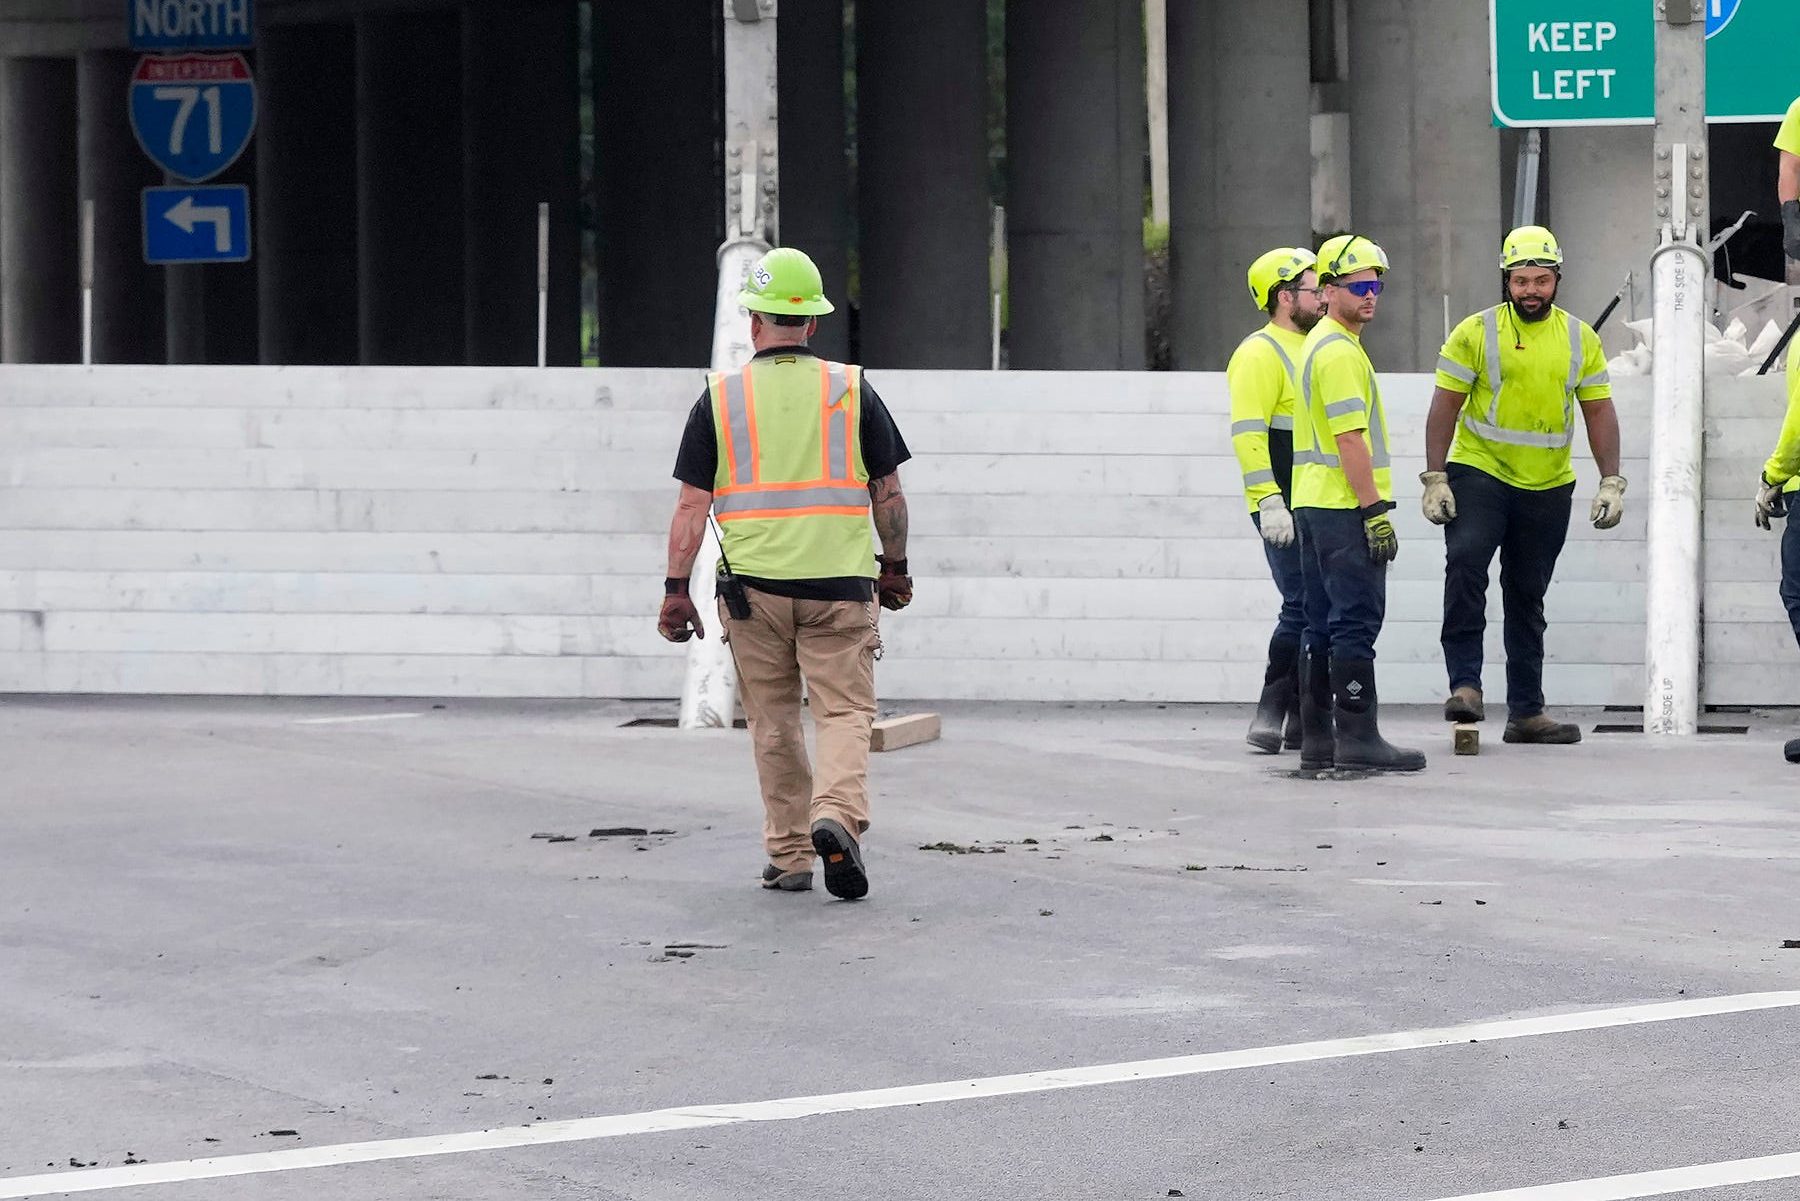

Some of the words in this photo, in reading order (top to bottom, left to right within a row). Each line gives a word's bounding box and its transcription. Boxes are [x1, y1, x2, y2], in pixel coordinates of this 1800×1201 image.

[1527, 21, 1617, 53] KEEP
[1532, 68, 1617, 101] LEFT
[153, 85, 222, 155] 71
[1675, 252, 1685, 265] UP
[1675, 268, 1685, 288] SIDE
[1675, 292, 1685, 311] THIS
[1663, 677, 1673, 691] UP
[1662, 694, 1673, 717] SIDE
